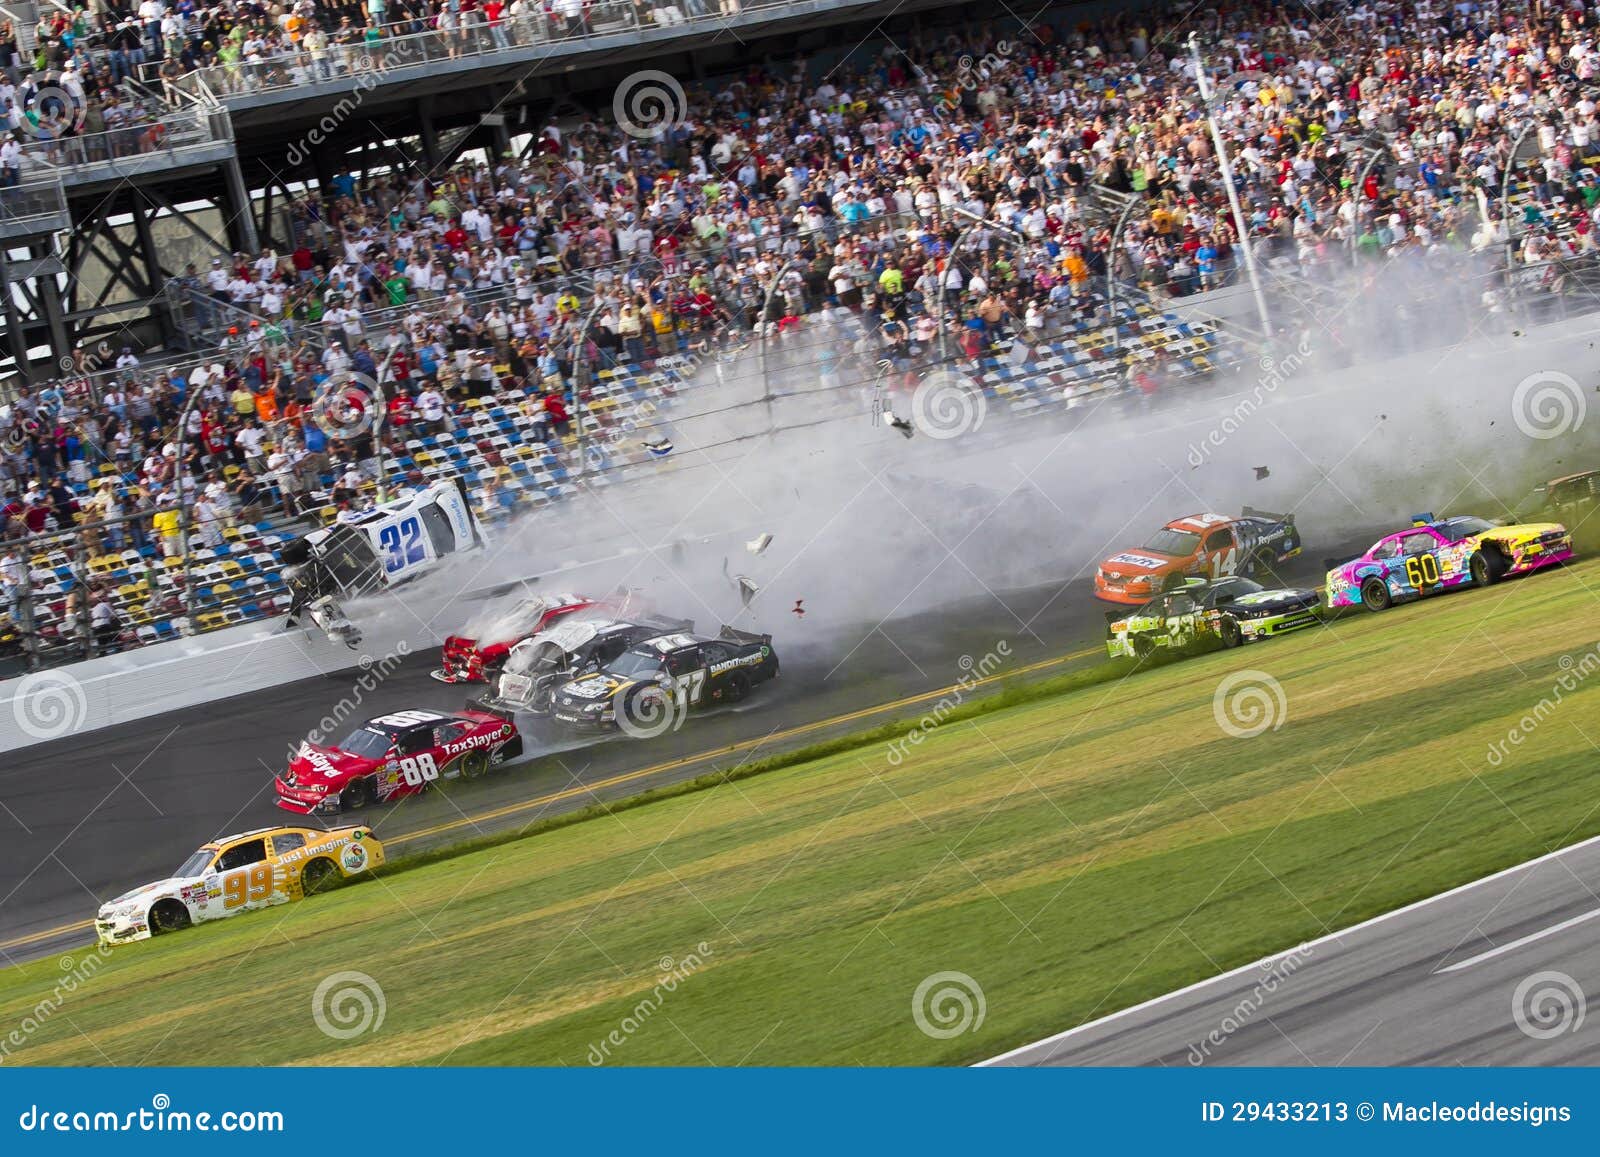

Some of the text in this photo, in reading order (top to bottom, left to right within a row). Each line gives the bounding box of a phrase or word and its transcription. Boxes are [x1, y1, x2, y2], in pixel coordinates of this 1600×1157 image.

[379, 516, 425, 574] 32
[1211, 547, 1237, 578] 14
[1405, 553, 1439, 588] 60
[442, 728, 503, 755] TaxSlayer
[400, 753, 439, 786] 88
[276, 837, 350, 866] Just Imagine
[223, 863, 274, 910] 99
